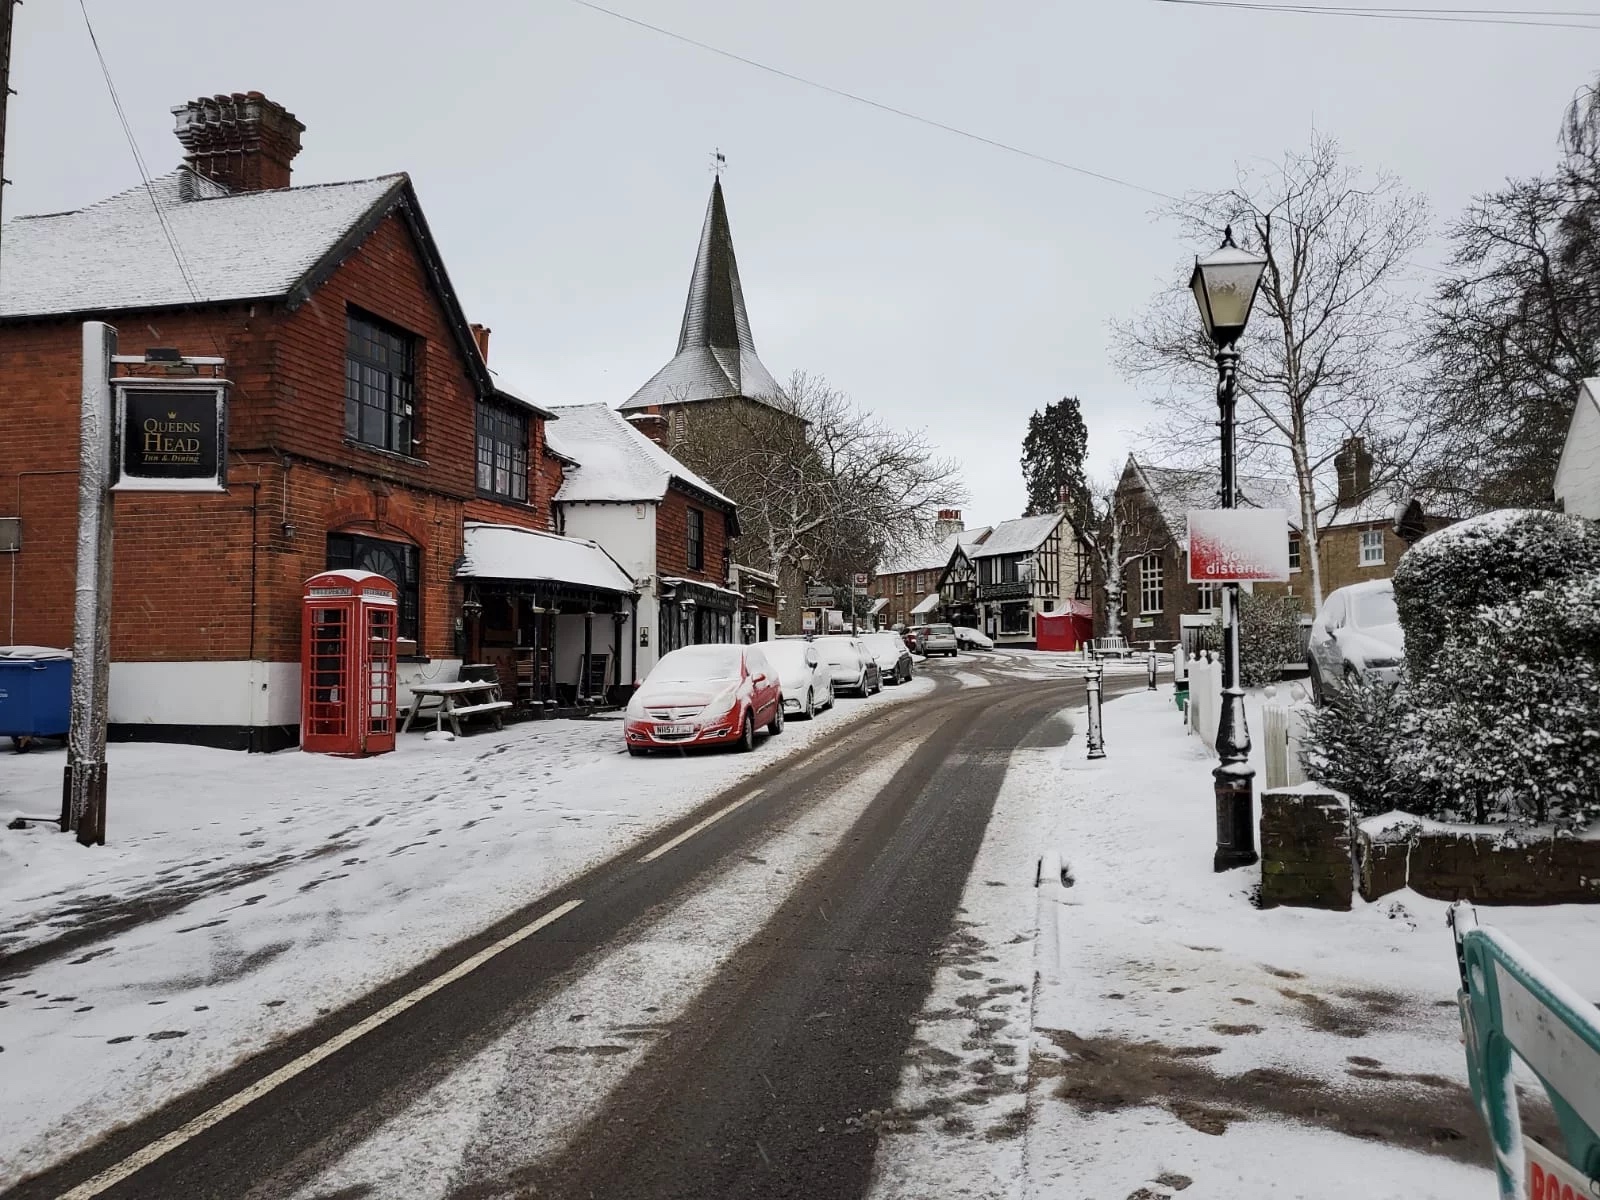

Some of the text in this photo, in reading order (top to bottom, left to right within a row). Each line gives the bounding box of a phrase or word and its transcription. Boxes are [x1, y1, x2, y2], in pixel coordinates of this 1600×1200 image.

[143, 418, 200, 435] QUEENS
[143, 433, 200, 452] HEAD
[171, 454, 200, 463] Dining
